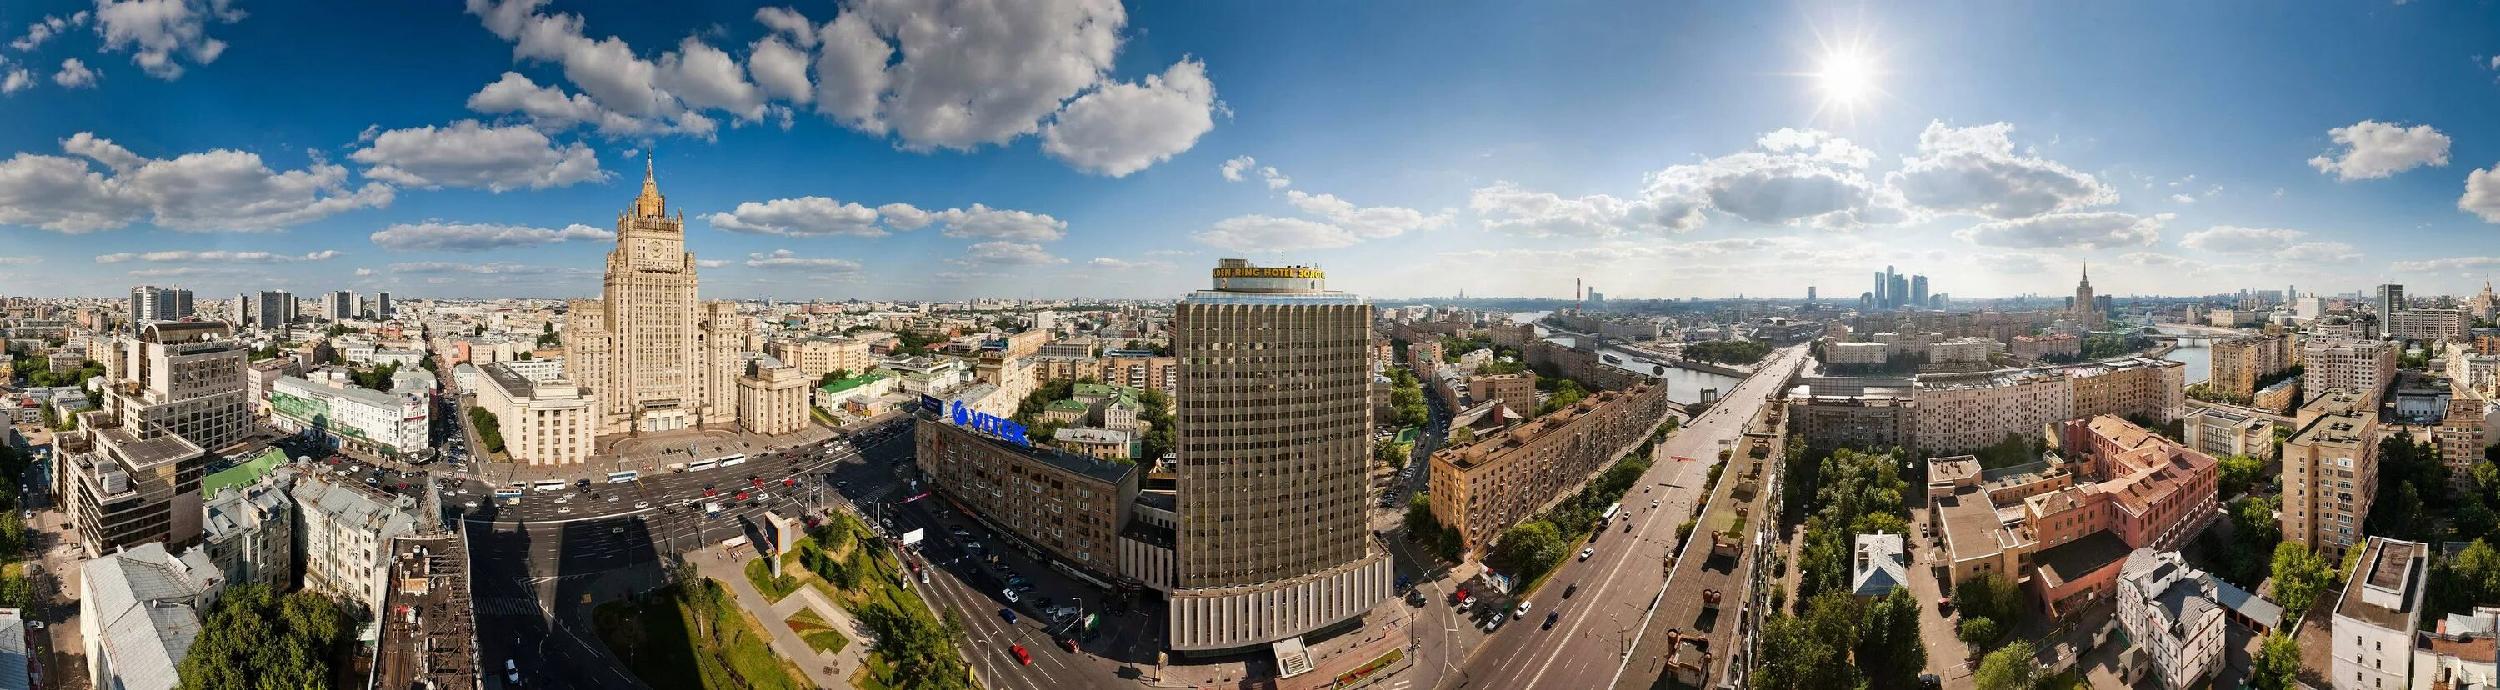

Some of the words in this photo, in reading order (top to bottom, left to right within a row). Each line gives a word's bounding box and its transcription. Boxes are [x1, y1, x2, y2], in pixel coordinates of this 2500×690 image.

[1235, 268, 1260, 277] RING
[1264, 268, 1295, 278] HOTEL
[970, 408, 1030, 449] VITEK
